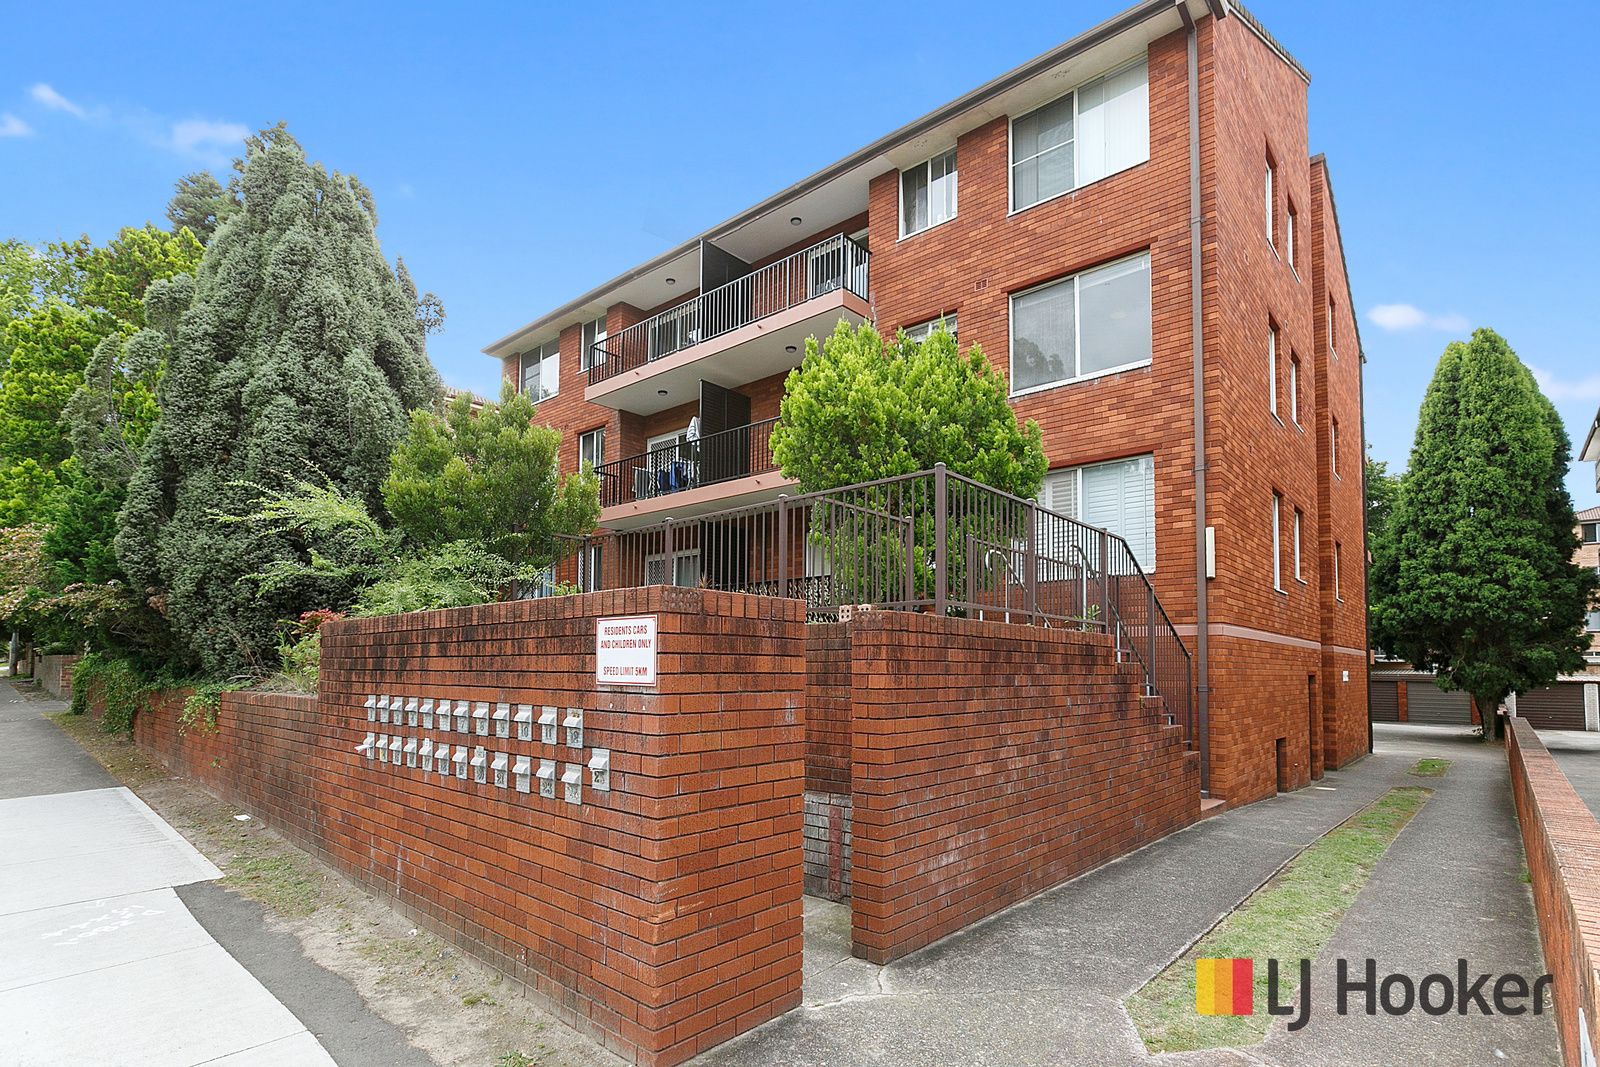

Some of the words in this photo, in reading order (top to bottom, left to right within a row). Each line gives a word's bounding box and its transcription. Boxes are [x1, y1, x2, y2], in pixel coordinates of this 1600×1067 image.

[604, 625, 632, 636] RESIDENTS
[632, 624, 648, 635] CARS
[600, 639, 611, 649] AND
[611, 639, 637, 649] CHILDREN
[637, 639, 652, 649] ONLY
[603, 666, 619, 676] SPEED
[620, 666, 634, 676] LIMIT
[635, 666, 648, 677] 5KM
[520, 725, 530, 738] 10
[544, 728, 553, 741] 11
